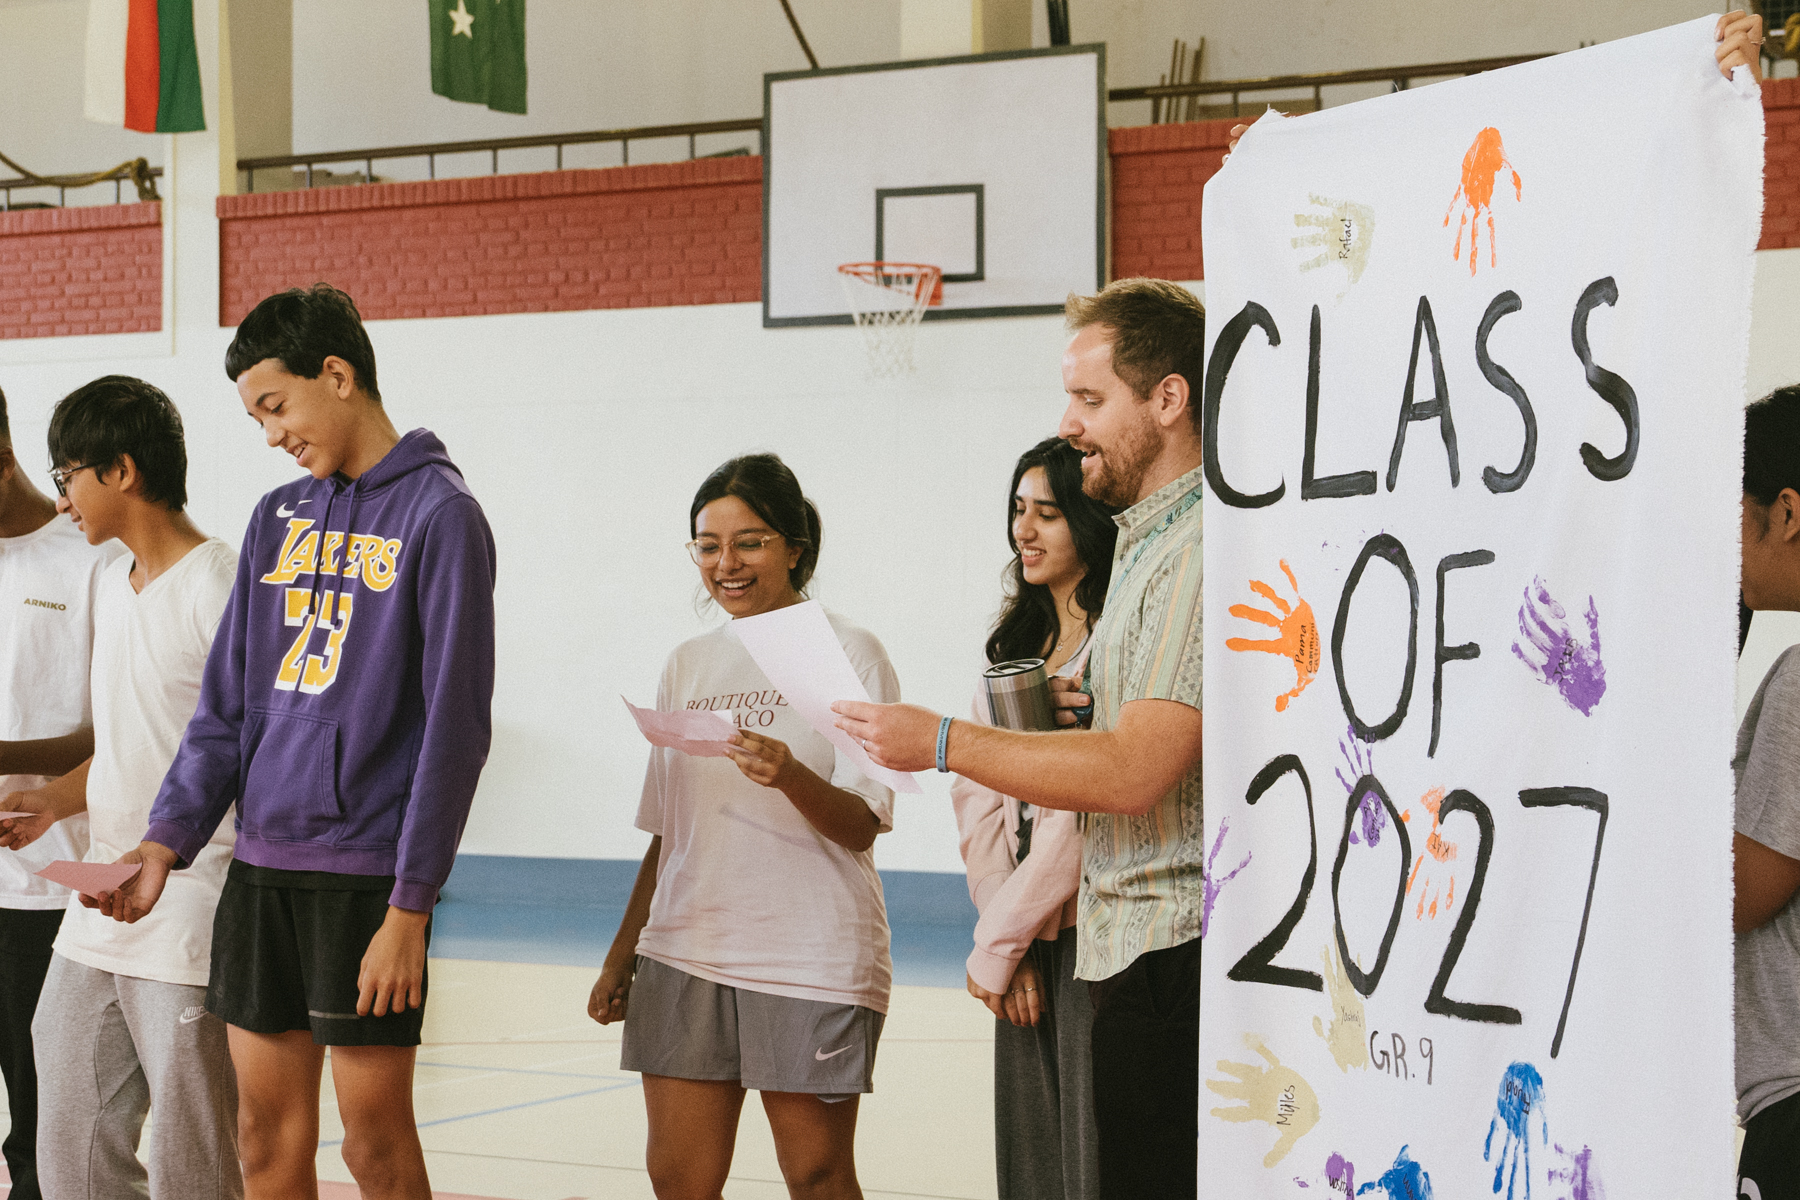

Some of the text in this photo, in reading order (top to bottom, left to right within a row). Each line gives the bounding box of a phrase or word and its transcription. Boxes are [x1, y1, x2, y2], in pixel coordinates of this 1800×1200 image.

[1203, 276, 1640, 509] CLASS
[24, 598, 66, 611] ARNIKO
[260, 518, 402, 592] LAKERS
[274, 587, 353, 695] 23
[1331, 533, 1496, 759] OF
[686, 690, 789, 711] BOUTIQUE
[1227, 753, 1609, 1059] 2027
